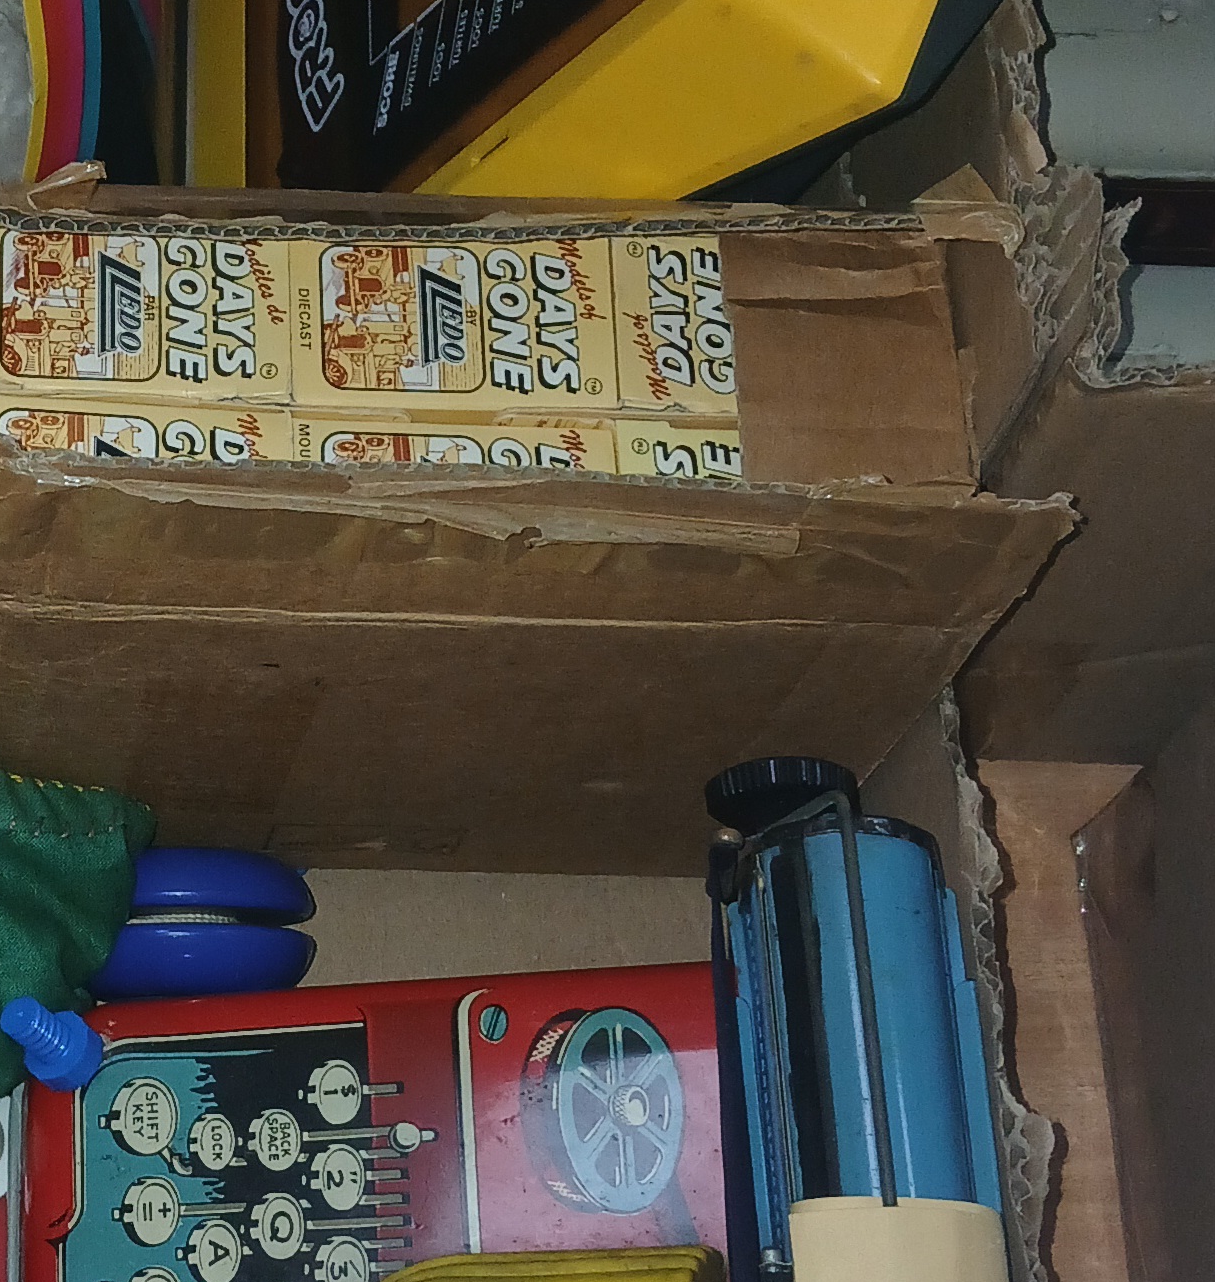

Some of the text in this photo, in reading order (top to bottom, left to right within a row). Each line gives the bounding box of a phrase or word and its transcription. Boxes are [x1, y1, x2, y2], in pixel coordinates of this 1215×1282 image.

[451, 9, 469, 66] TURTLES
[471, 7, 485, 49] LOGS
[403, 27, 424, 107] DWELLINGS
[432, 42, 446, 82] LOGS
[377, 50, 400, 129] SCORE
[145, 295, 155, 322] PAR
[164, 237, 209, 383] GONE
[210, 239, 258, 379] DAYS
[268, 302, 288, 325] de
[299, 288, 312, 350] DIECAST
[466, 309, 477, 327] BY
[486, 248, 534, 394] GONE
[531, 251, 581, 394] DAYS
[647, 244, 695, 387] DAYS
[691, 246, 736, 394] GONE
[633, 331, 671, 401] Models
[132, 1104, 145, 1138] KEY
[146, 1091, 160, 1142] SHIFT
[211, 1125, 223, 1161] LOCK
[267, 1118, 280, 1161] SPACE
[279, 1122, 292, 1157] BACK
[326, 1170, 344, 1191] 2
[270, 1211, 294, 1243] Q
[208, 1239, 231, 1267] A
[330, 1261, 348, 1281] 3
